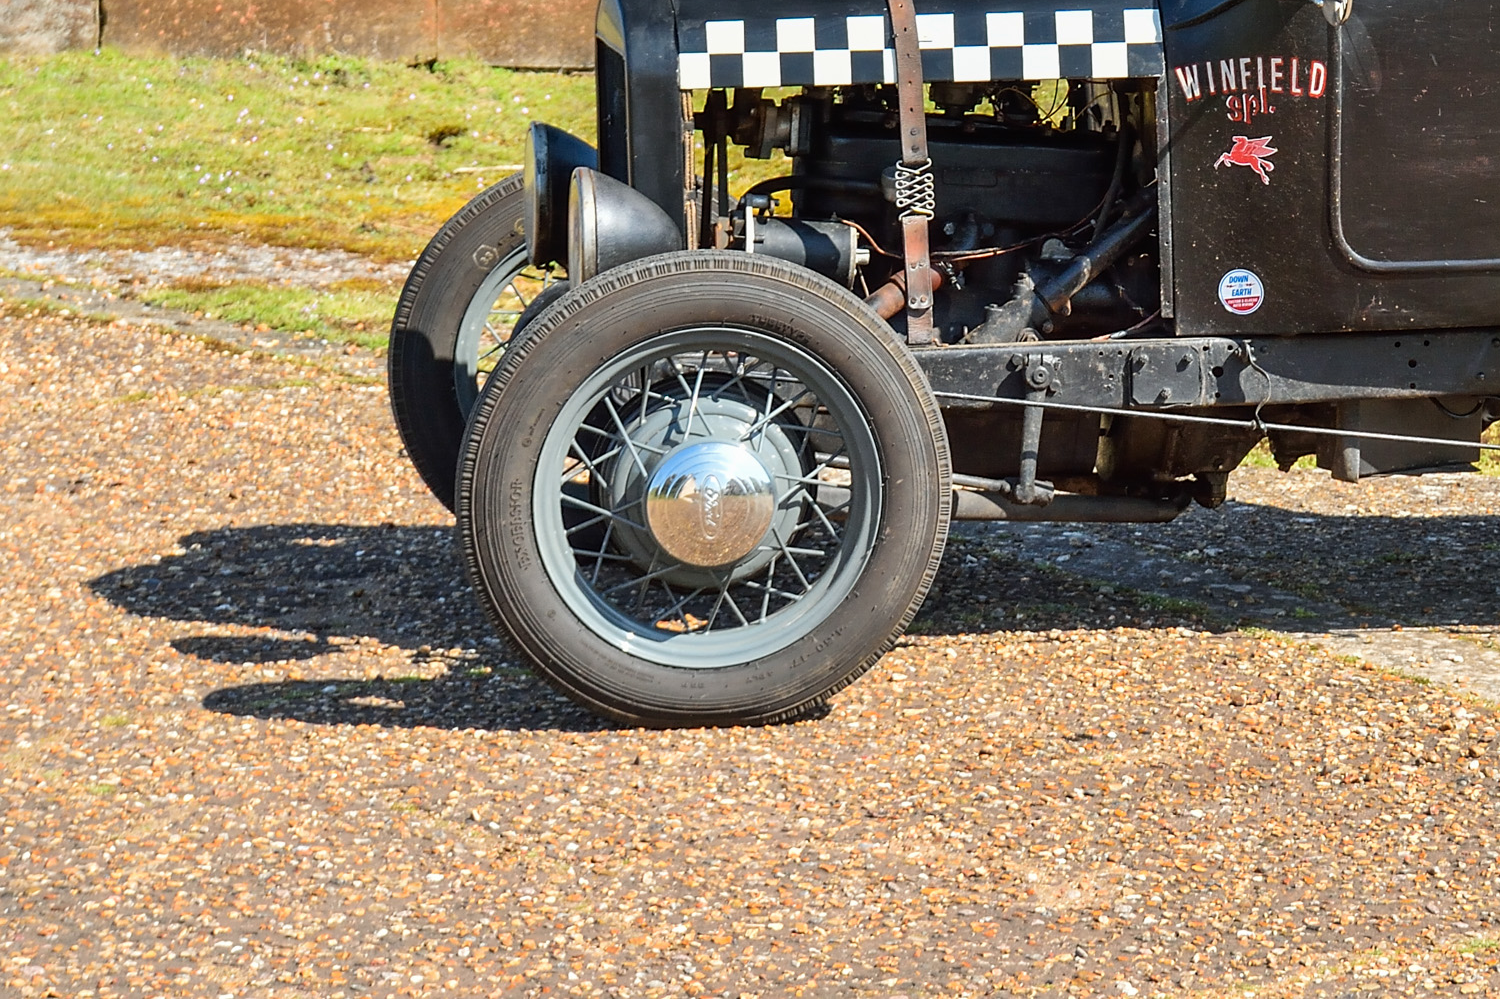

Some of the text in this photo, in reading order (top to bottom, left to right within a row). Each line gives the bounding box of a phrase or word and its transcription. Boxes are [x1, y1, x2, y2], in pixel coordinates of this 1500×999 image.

[1174, 56, 1328, 103] WINFIELD
[1228, 275, 1249, 283] DOWN
[1231, 288, 1252, 297] EARTH
[704, 486, 720, 527] Ford
